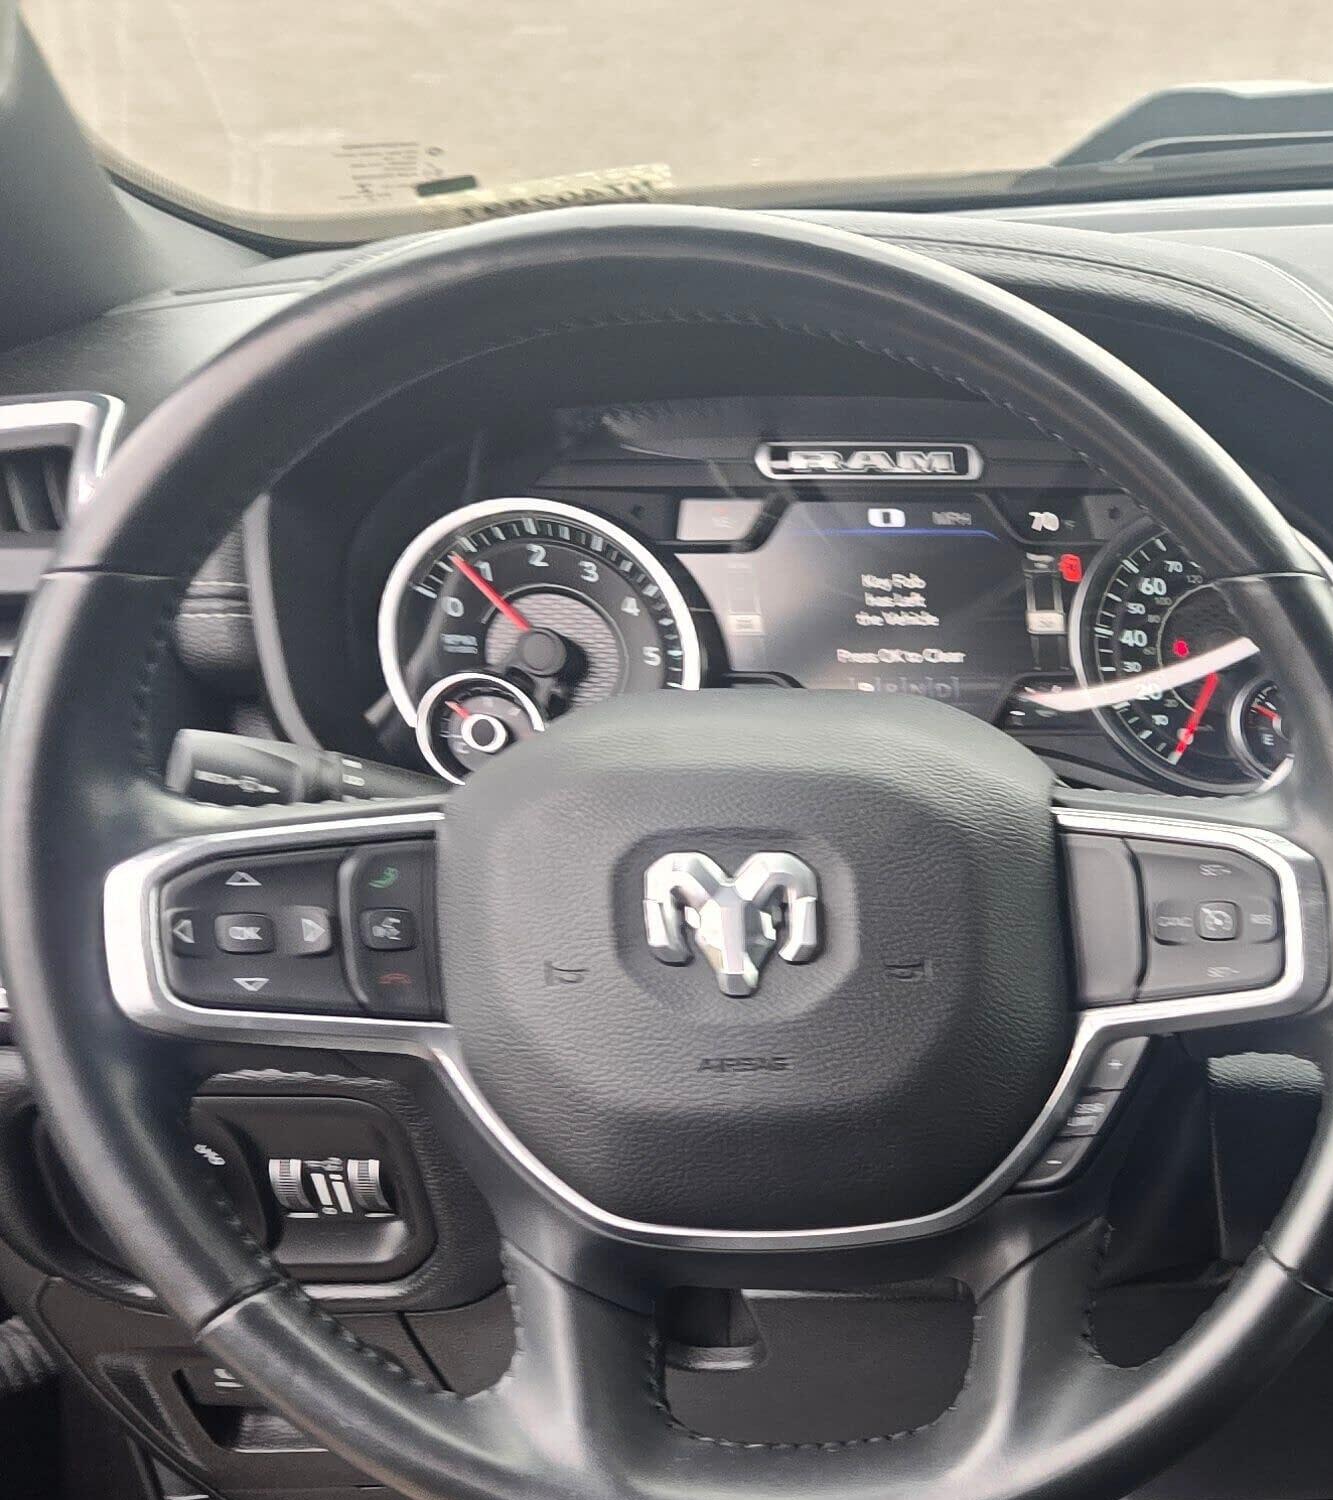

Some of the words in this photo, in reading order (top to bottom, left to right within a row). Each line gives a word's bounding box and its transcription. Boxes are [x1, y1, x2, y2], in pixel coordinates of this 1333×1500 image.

[788, 451, 957, 473] RAM
[526, 543, 549, 567] 2
[579, 560, 599, 583] 3
[1139, 577, 1167, 596] 60
[442, 596, 464, 617] 0
[620, 596, 640, 617] 4
[1120, 629, 1148, 648] 40
[642, 646, 662, 667] 5
